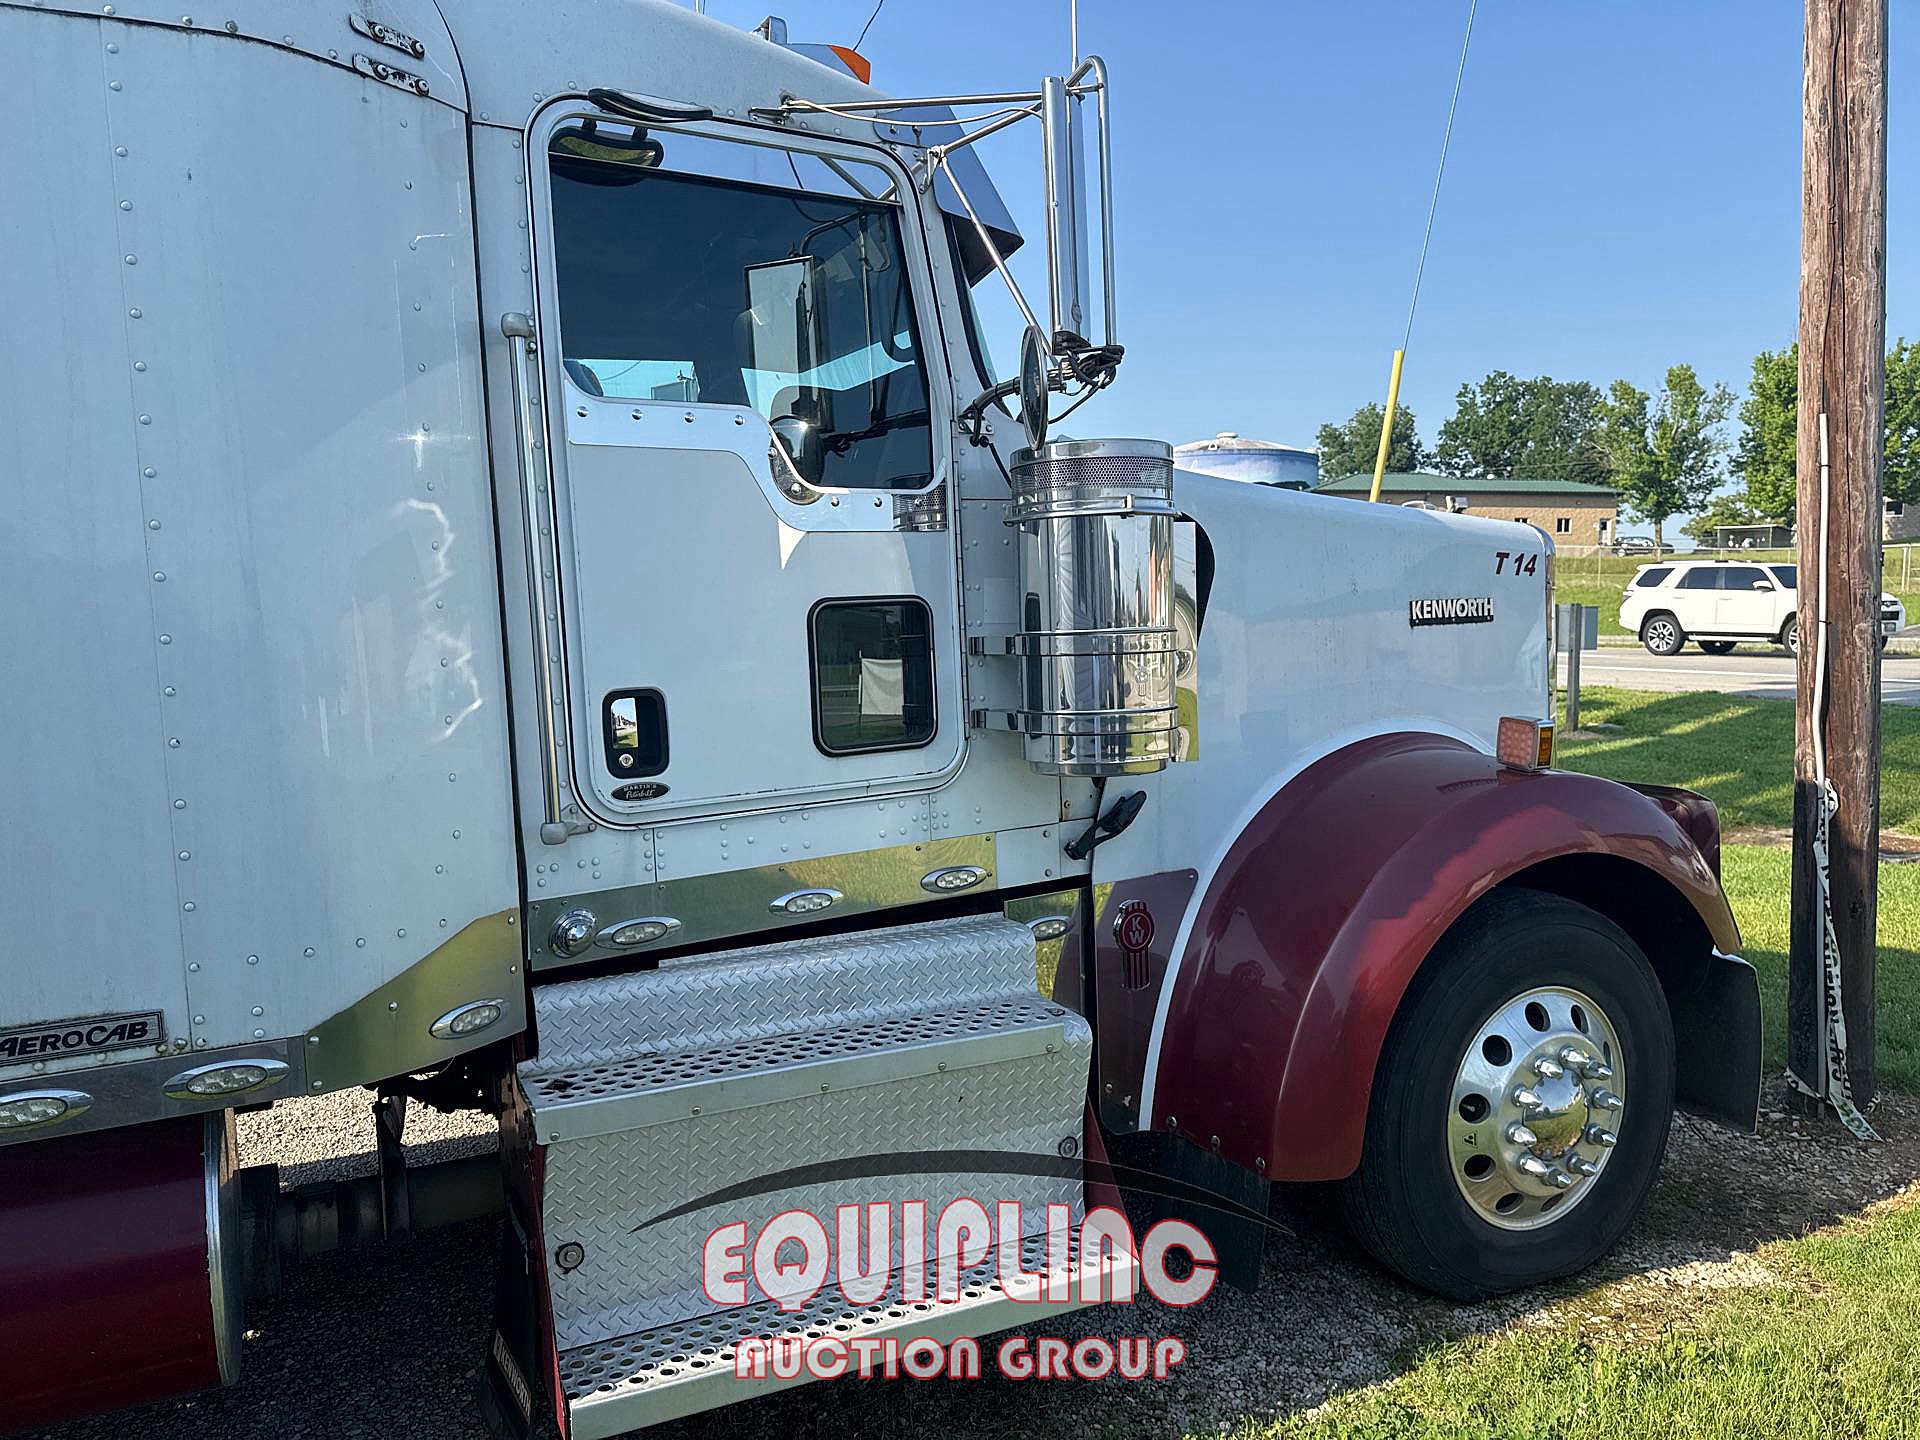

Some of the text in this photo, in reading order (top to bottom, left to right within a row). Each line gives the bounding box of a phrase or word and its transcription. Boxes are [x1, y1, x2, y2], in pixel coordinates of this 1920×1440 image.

[1495, 552, 1538, 577] T 14
[1412, 599, 1494, 620] KENWORTH
[0, 1021, 148, 1058] AEROCAB
[500, 1344, 531, 1418] KENWORTH
